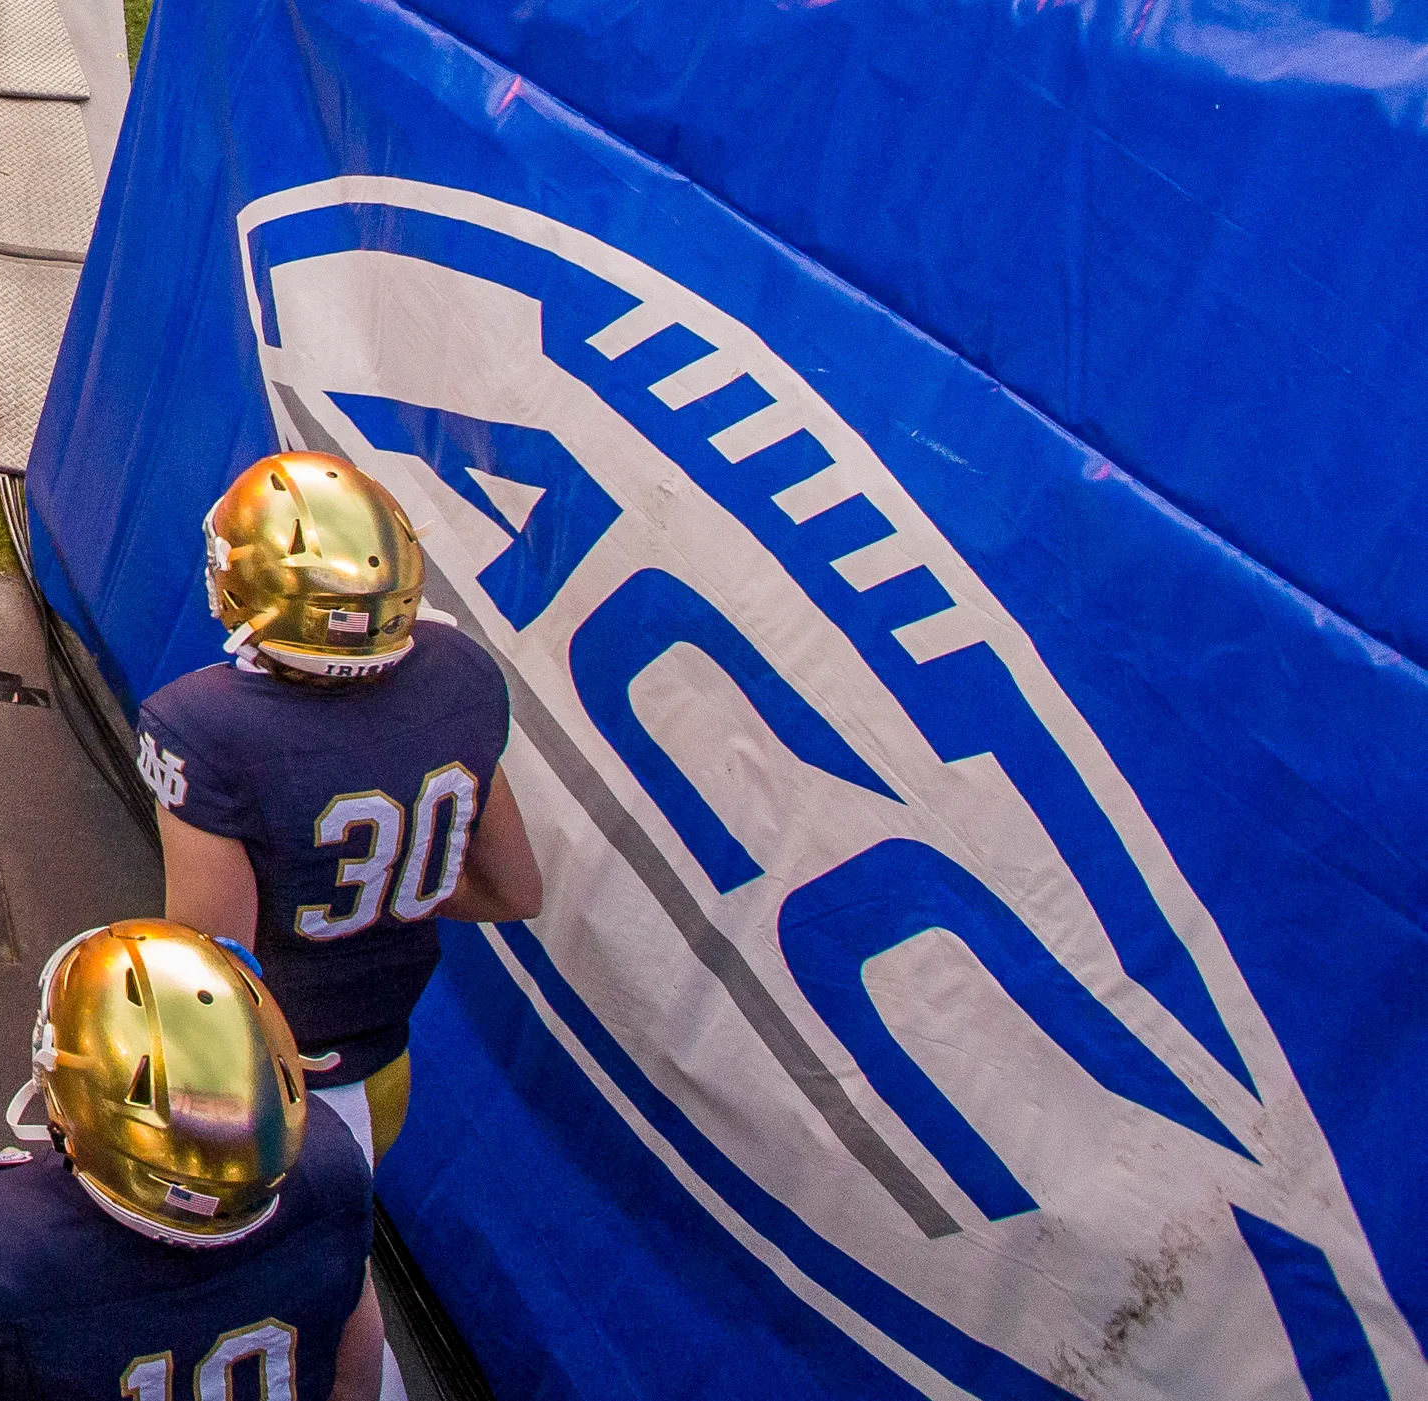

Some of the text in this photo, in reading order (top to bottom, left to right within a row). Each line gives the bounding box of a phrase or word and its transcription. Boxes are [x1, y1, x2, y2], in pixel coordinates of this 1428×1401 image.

[324, 660, 397, 678] IRISH
[294, 760, 479, 942] 30
[323, 390, 1264, 1223] ACC
